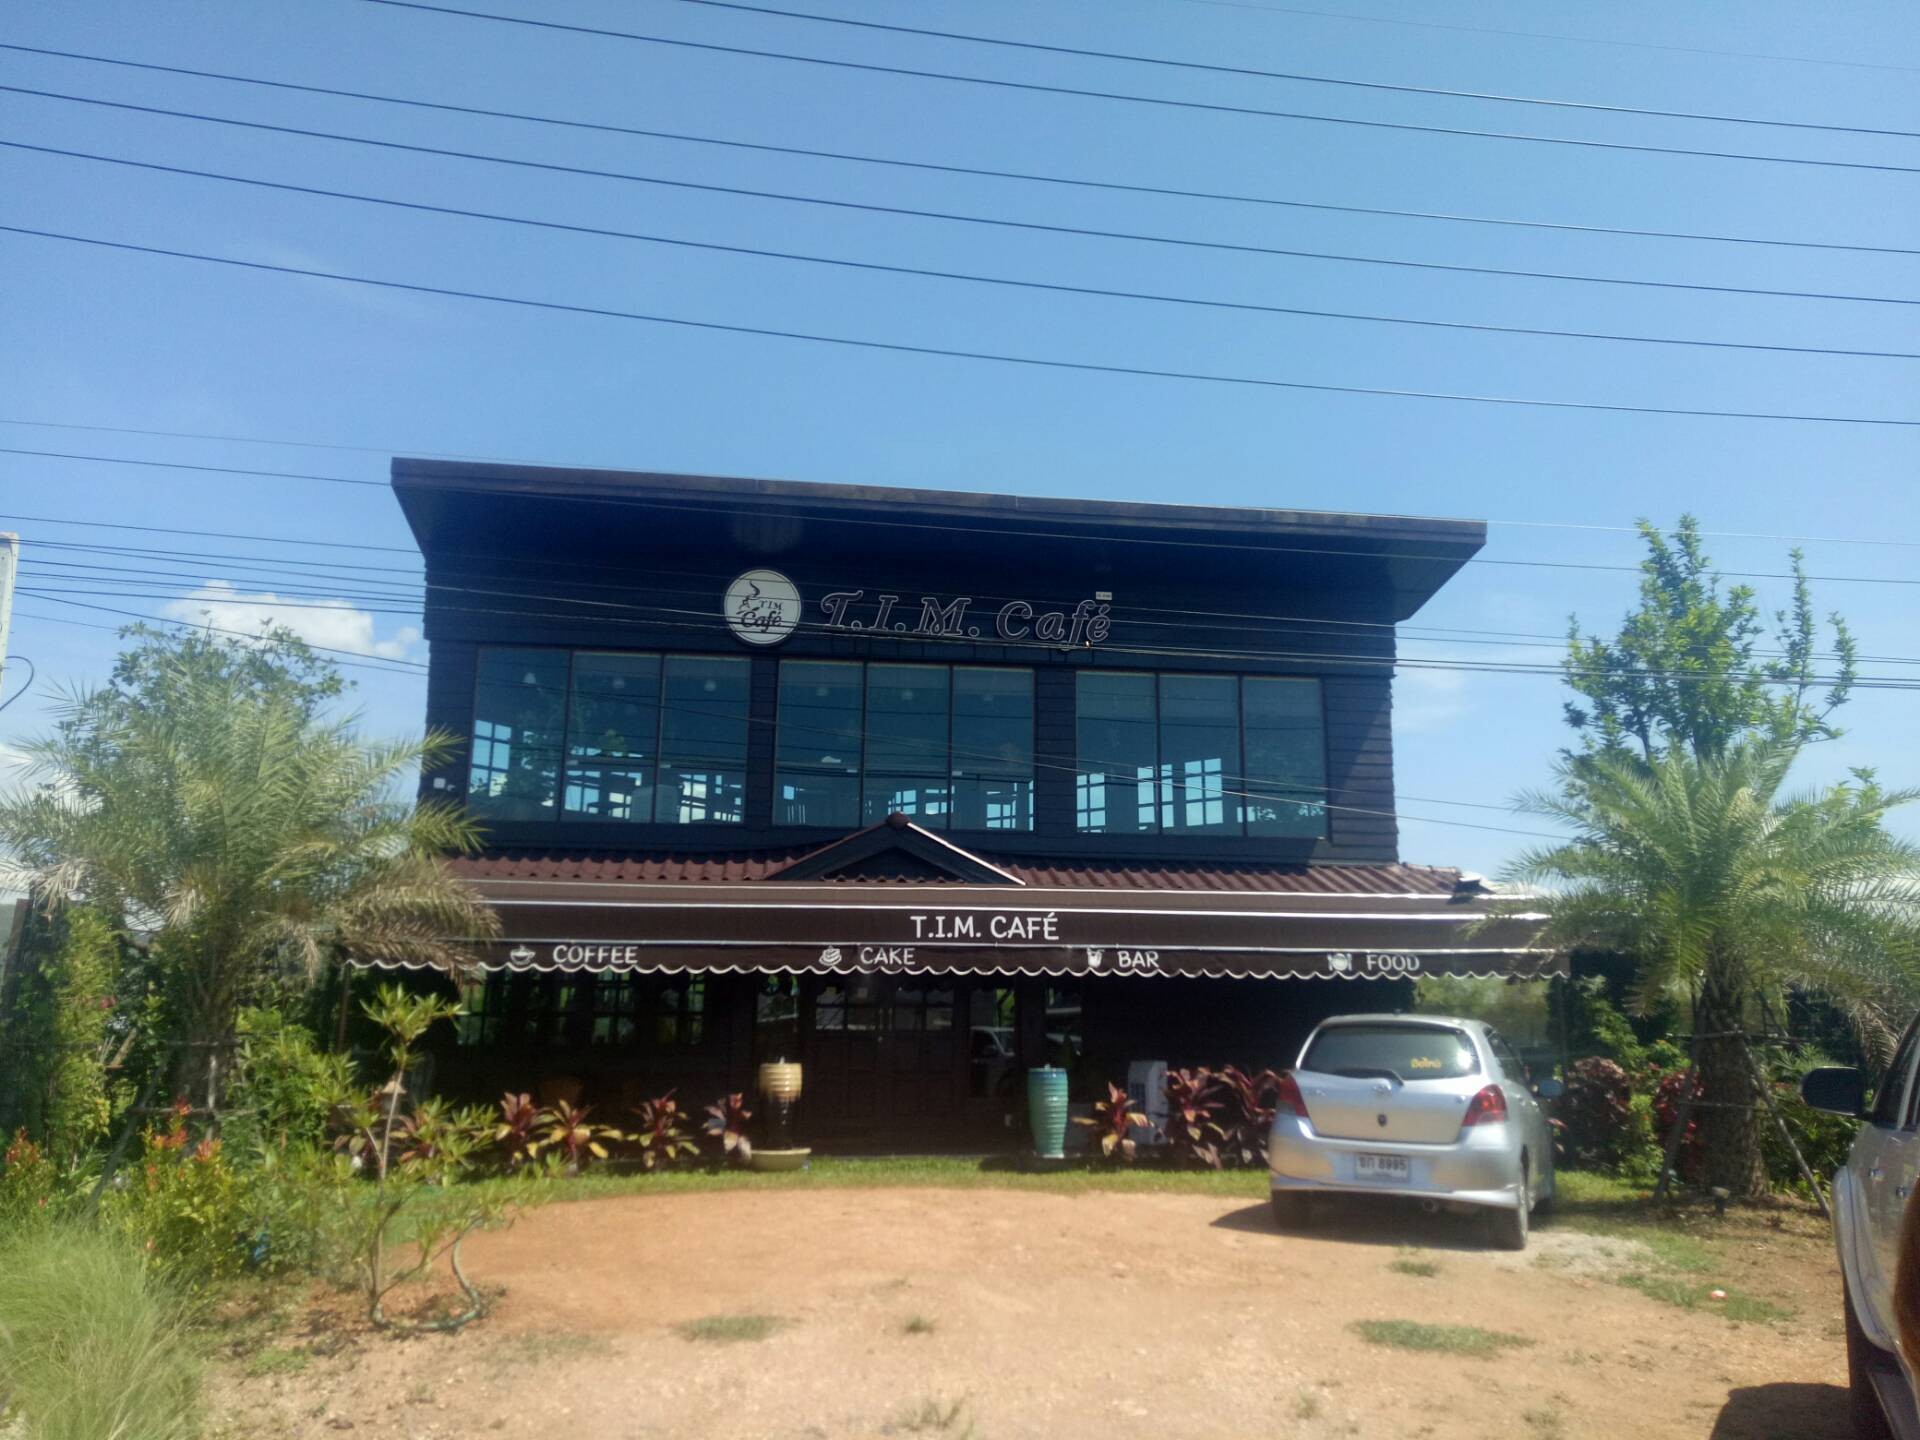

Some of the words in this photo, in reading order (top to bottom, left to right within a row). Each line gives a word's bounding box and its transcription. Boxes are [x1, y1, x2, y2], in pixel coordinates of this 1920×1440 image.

[741, 610, 782, 633] Café
[820, 589, 980, 638] T.I.M.
[996, 599, 1112, 646] Café
[910, 915, 982, 939] T.I.M.
[990, 911, 1060, 941] CAFÉ
[552, 944, 639, 965] COFFEE
[860, 947, 917, 966] CAKE
[1117, 950, 1160, 968] BAR
[1366, 954, 1420, 972] FOOD
